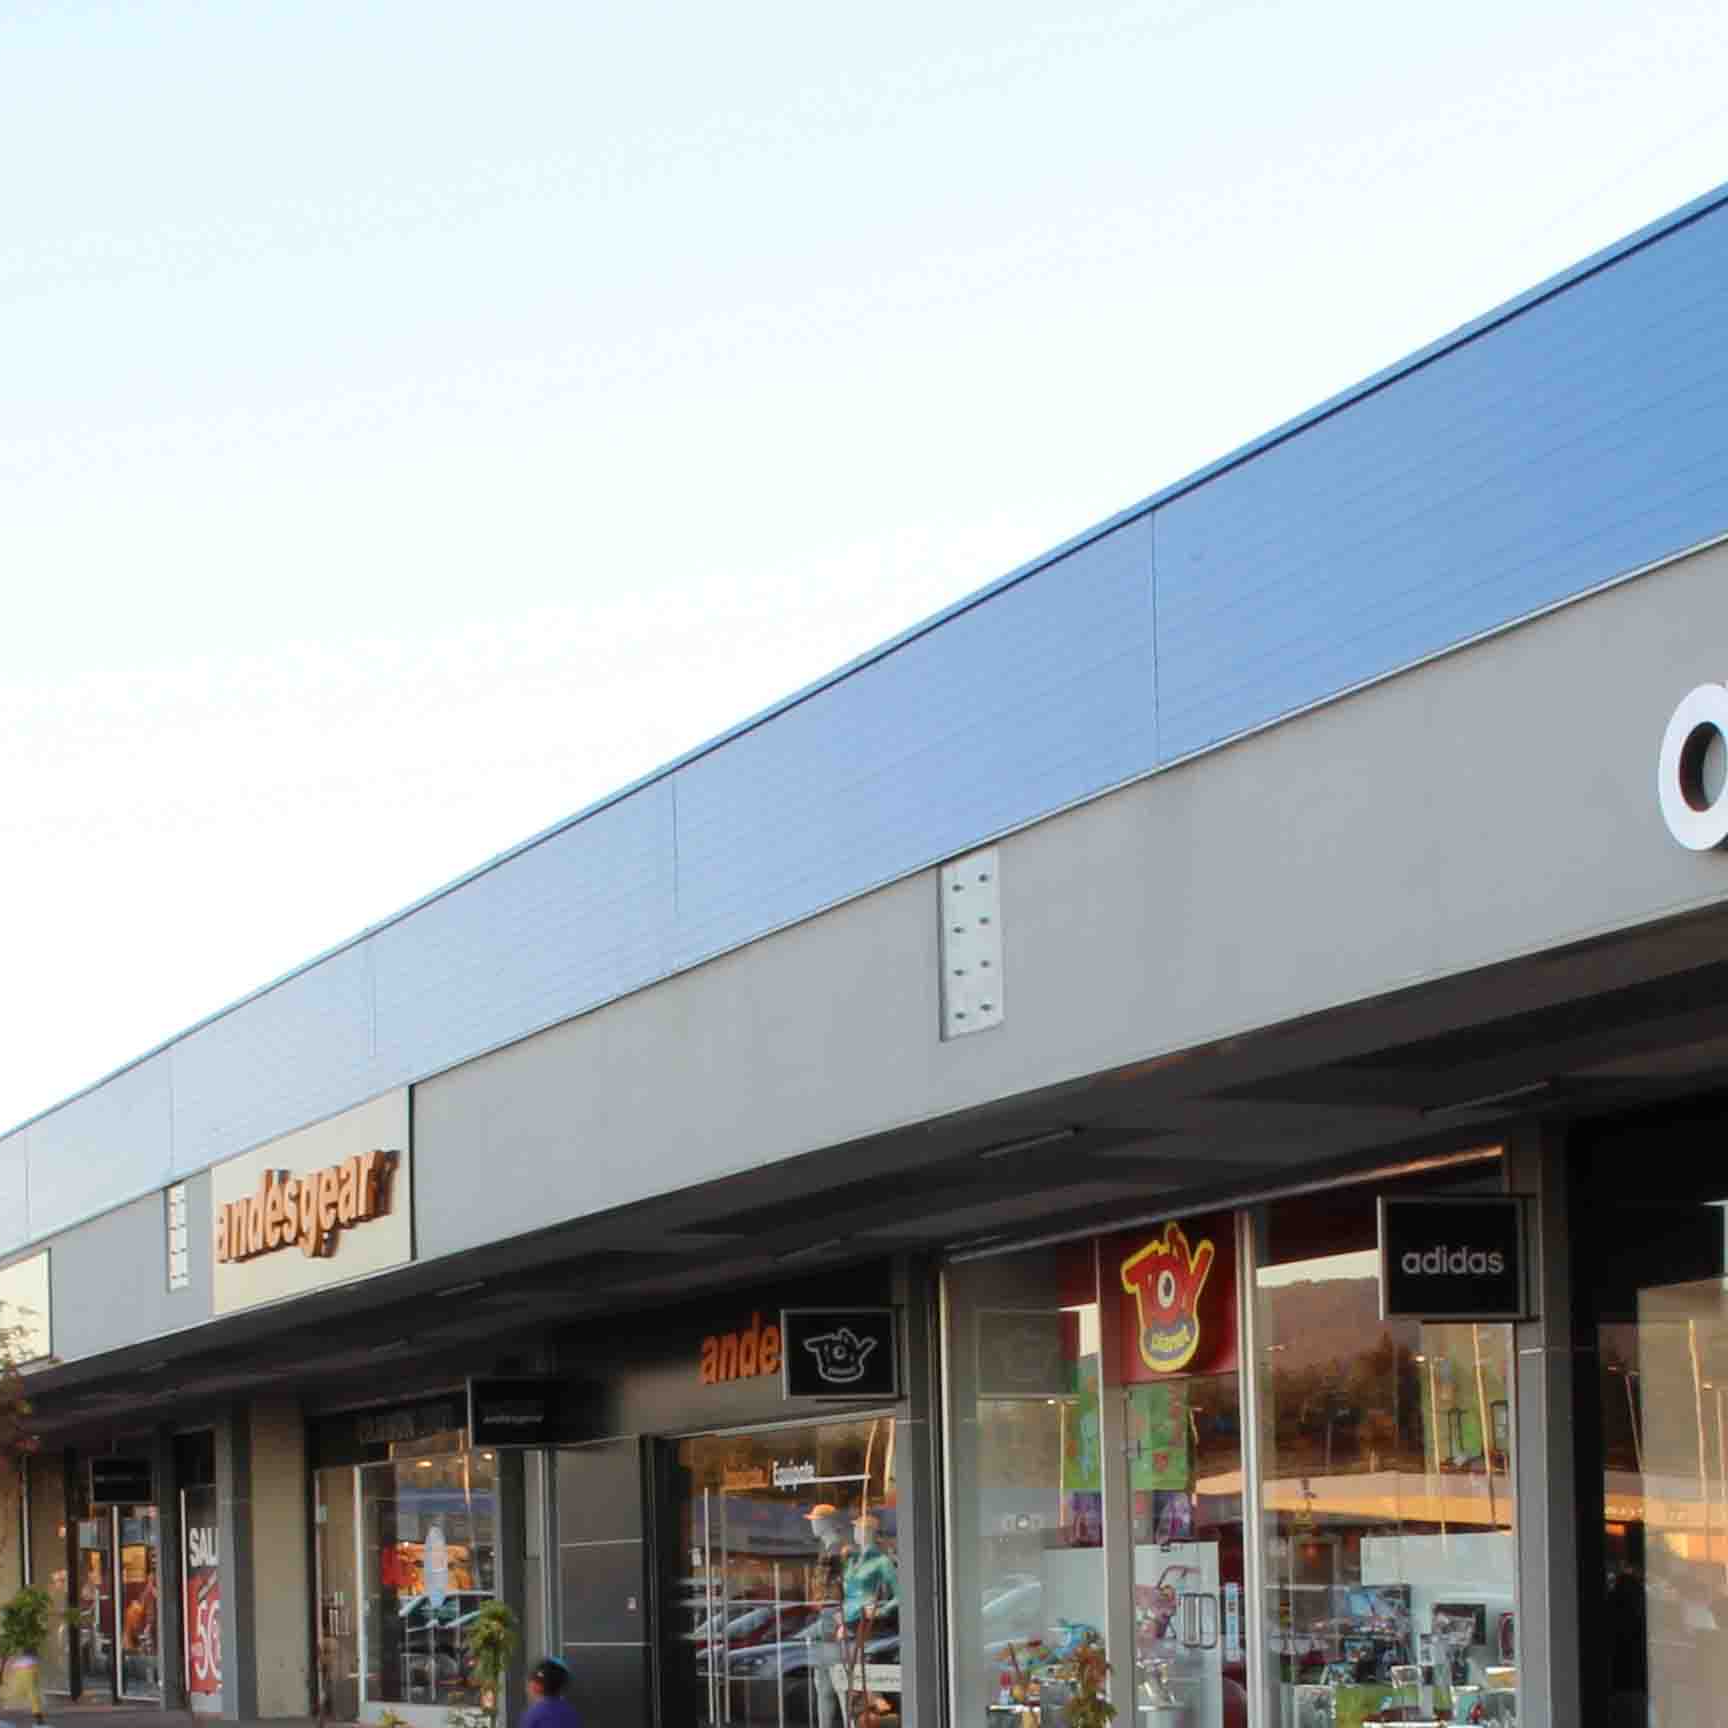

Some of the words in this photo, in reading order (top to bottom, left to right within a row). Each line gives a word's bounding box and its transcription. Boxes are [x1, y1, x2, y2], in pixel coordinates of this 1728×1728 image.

[217, 1150, 388, 1262] andesgear
[1401, 1245, 1505, 1275] adidas
[700, 1312, 783, 1385] ande
